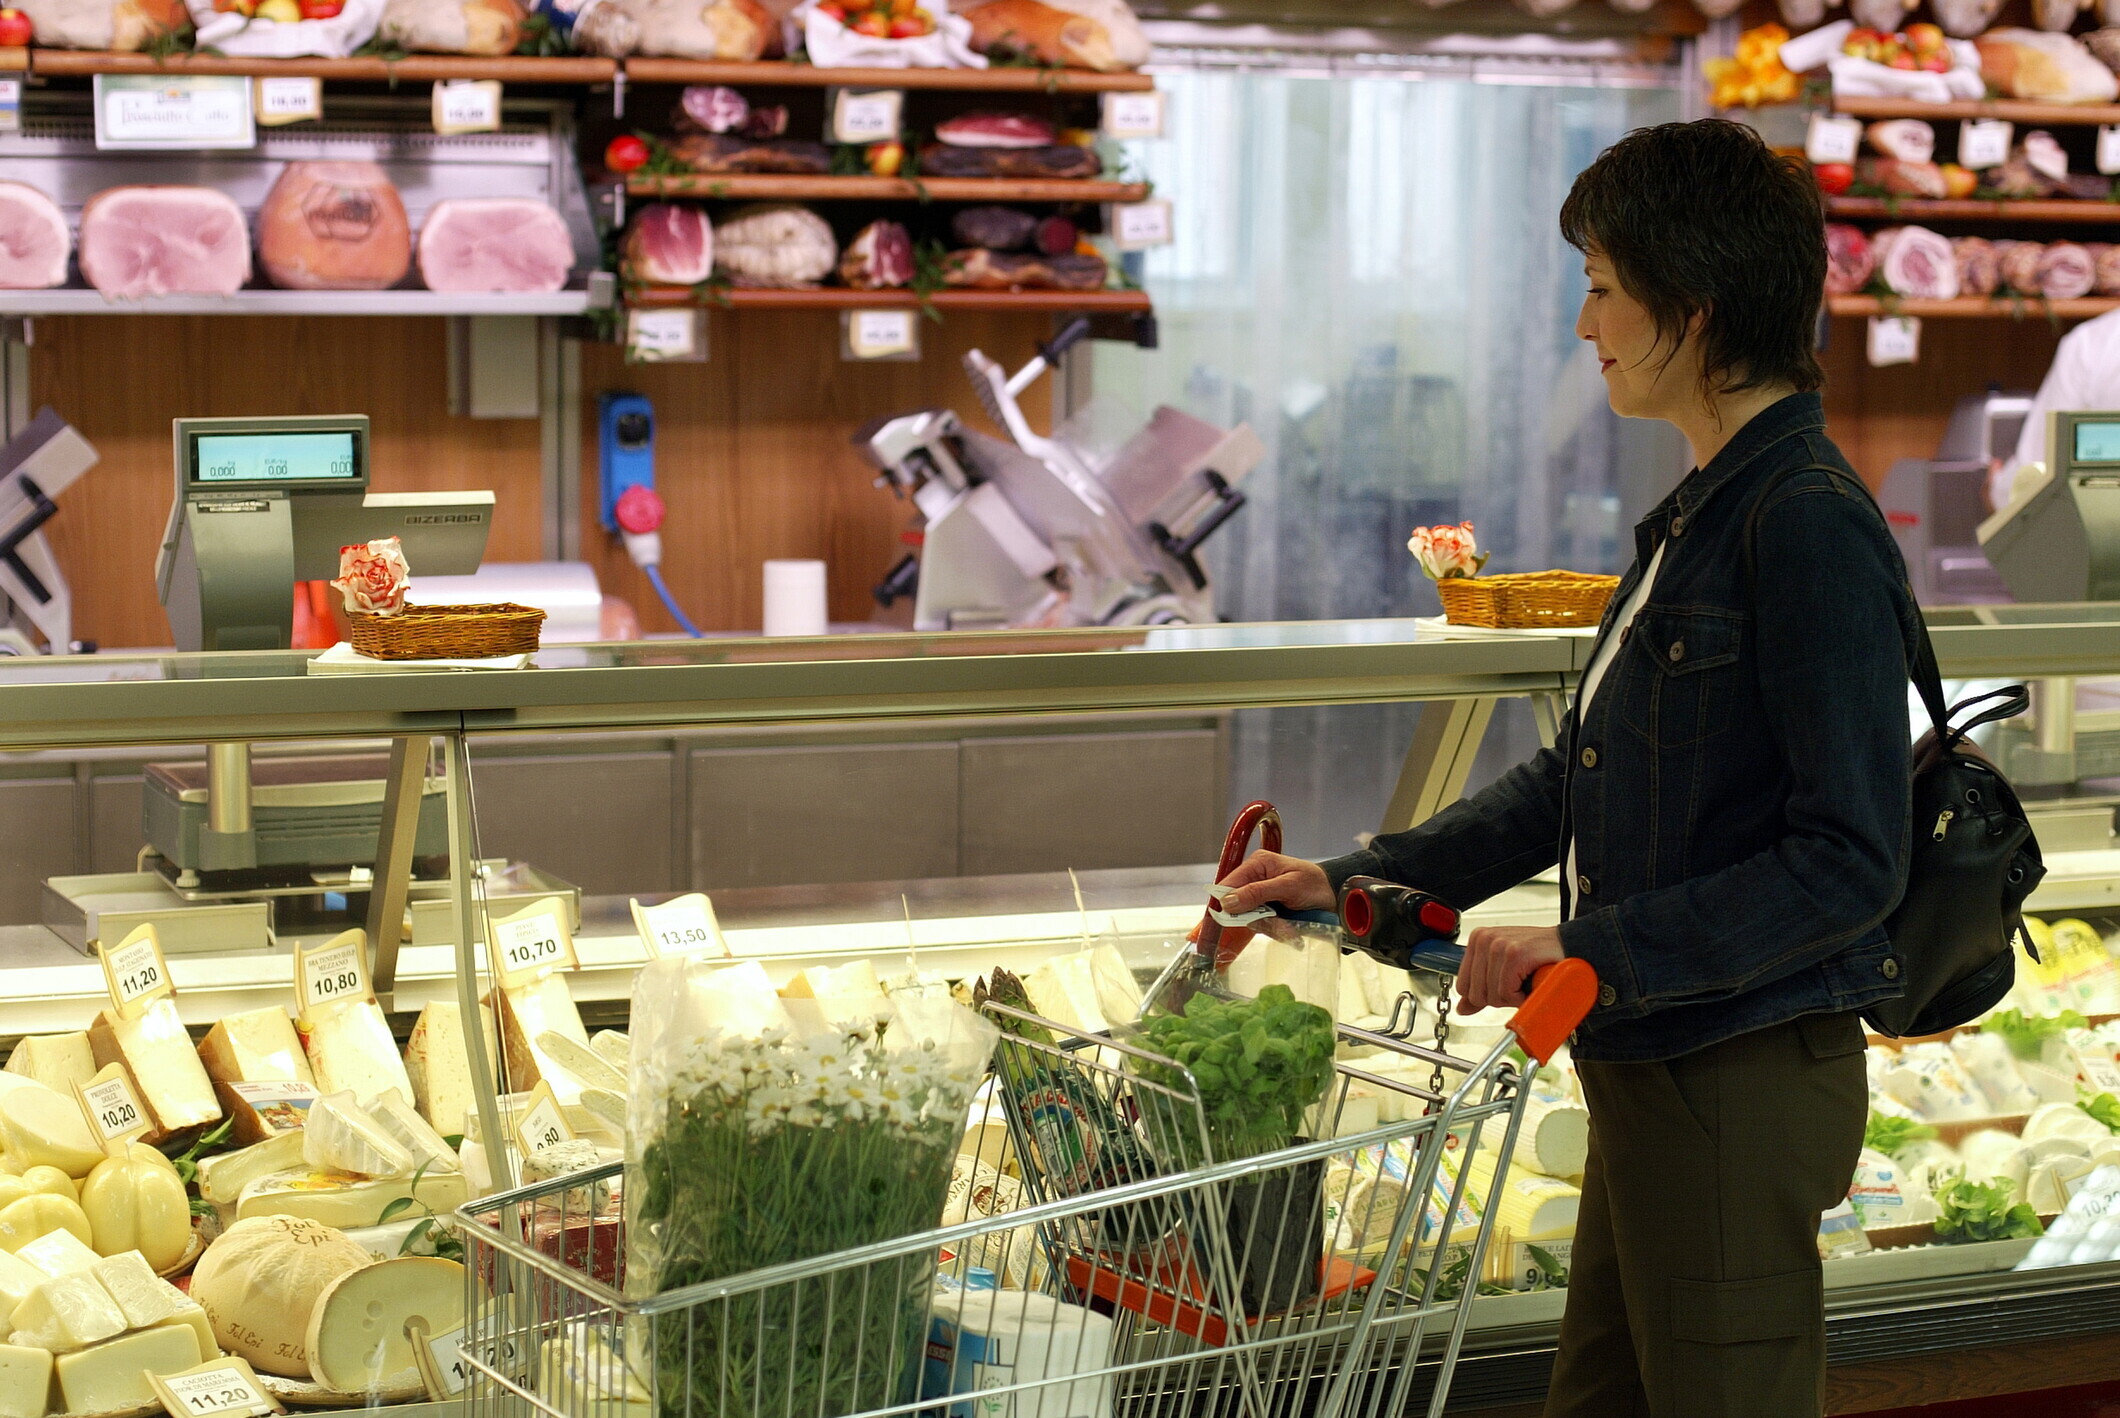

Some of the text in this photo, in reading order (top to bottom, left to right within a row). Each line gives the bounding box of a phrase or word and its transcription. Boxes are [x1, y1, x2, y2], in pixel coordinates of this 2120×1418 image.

[405, 514, 481, 525] BIZERBA
[661, 928, 707, 947] 13,50
[509, 939, 557, 963] 10,70
[318, 959, 349, 971] MEZZANO
[123, 967, 157, 994] 11,20
[315, 972, 357, 996] 10,80
[101, 1093, 118, 1104] DOLCE
[102, 1104, 136, 1128] 10,20
[182, 1374, 223, 1386] CACIOTTA
[191, 1388, 250, 1409] 11,20
